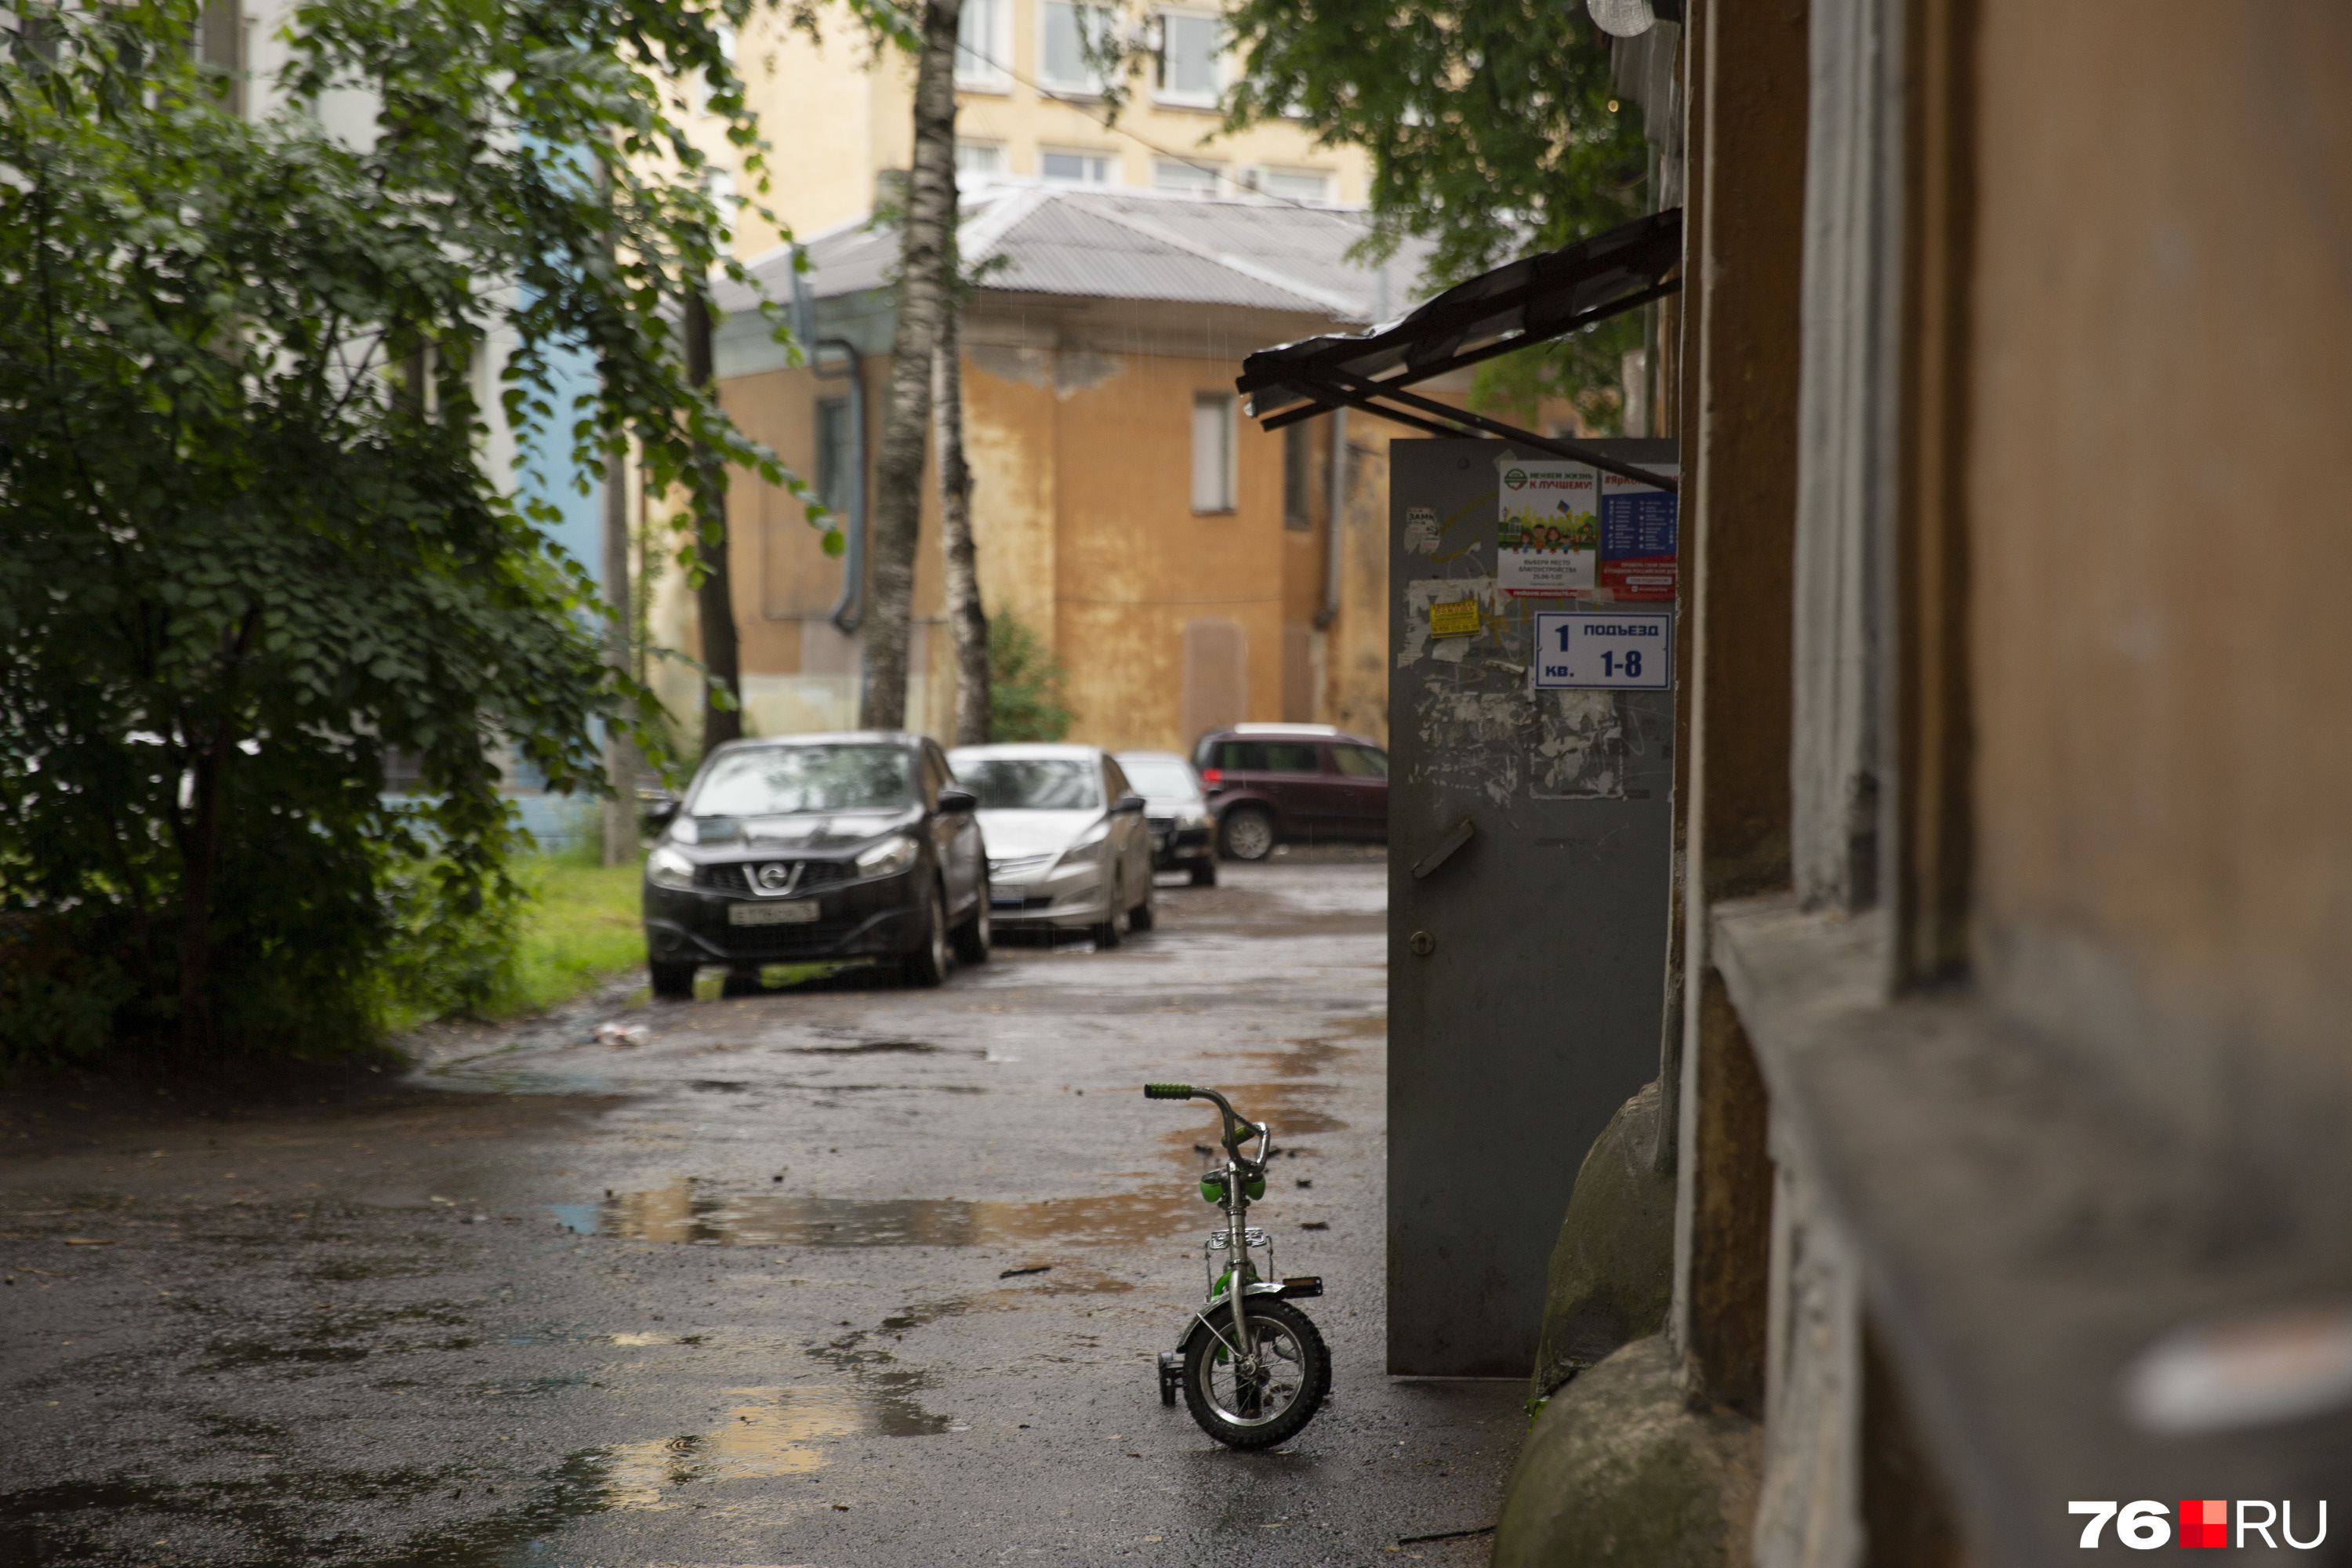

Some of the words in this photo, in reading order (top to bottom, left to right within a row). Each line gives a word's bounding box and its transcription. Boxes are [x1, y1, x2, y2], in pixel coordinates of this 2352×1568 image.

[1530, 481, 1537, 489] К
[1538, 481, 1592, 490] ЛУЧШЕМУ!
[1555, 624, 1569, 652] 1
[1584, 624, 1660, 637] ПОДЪЕЗД
[1600, 650, 1642, 678] 1-8
